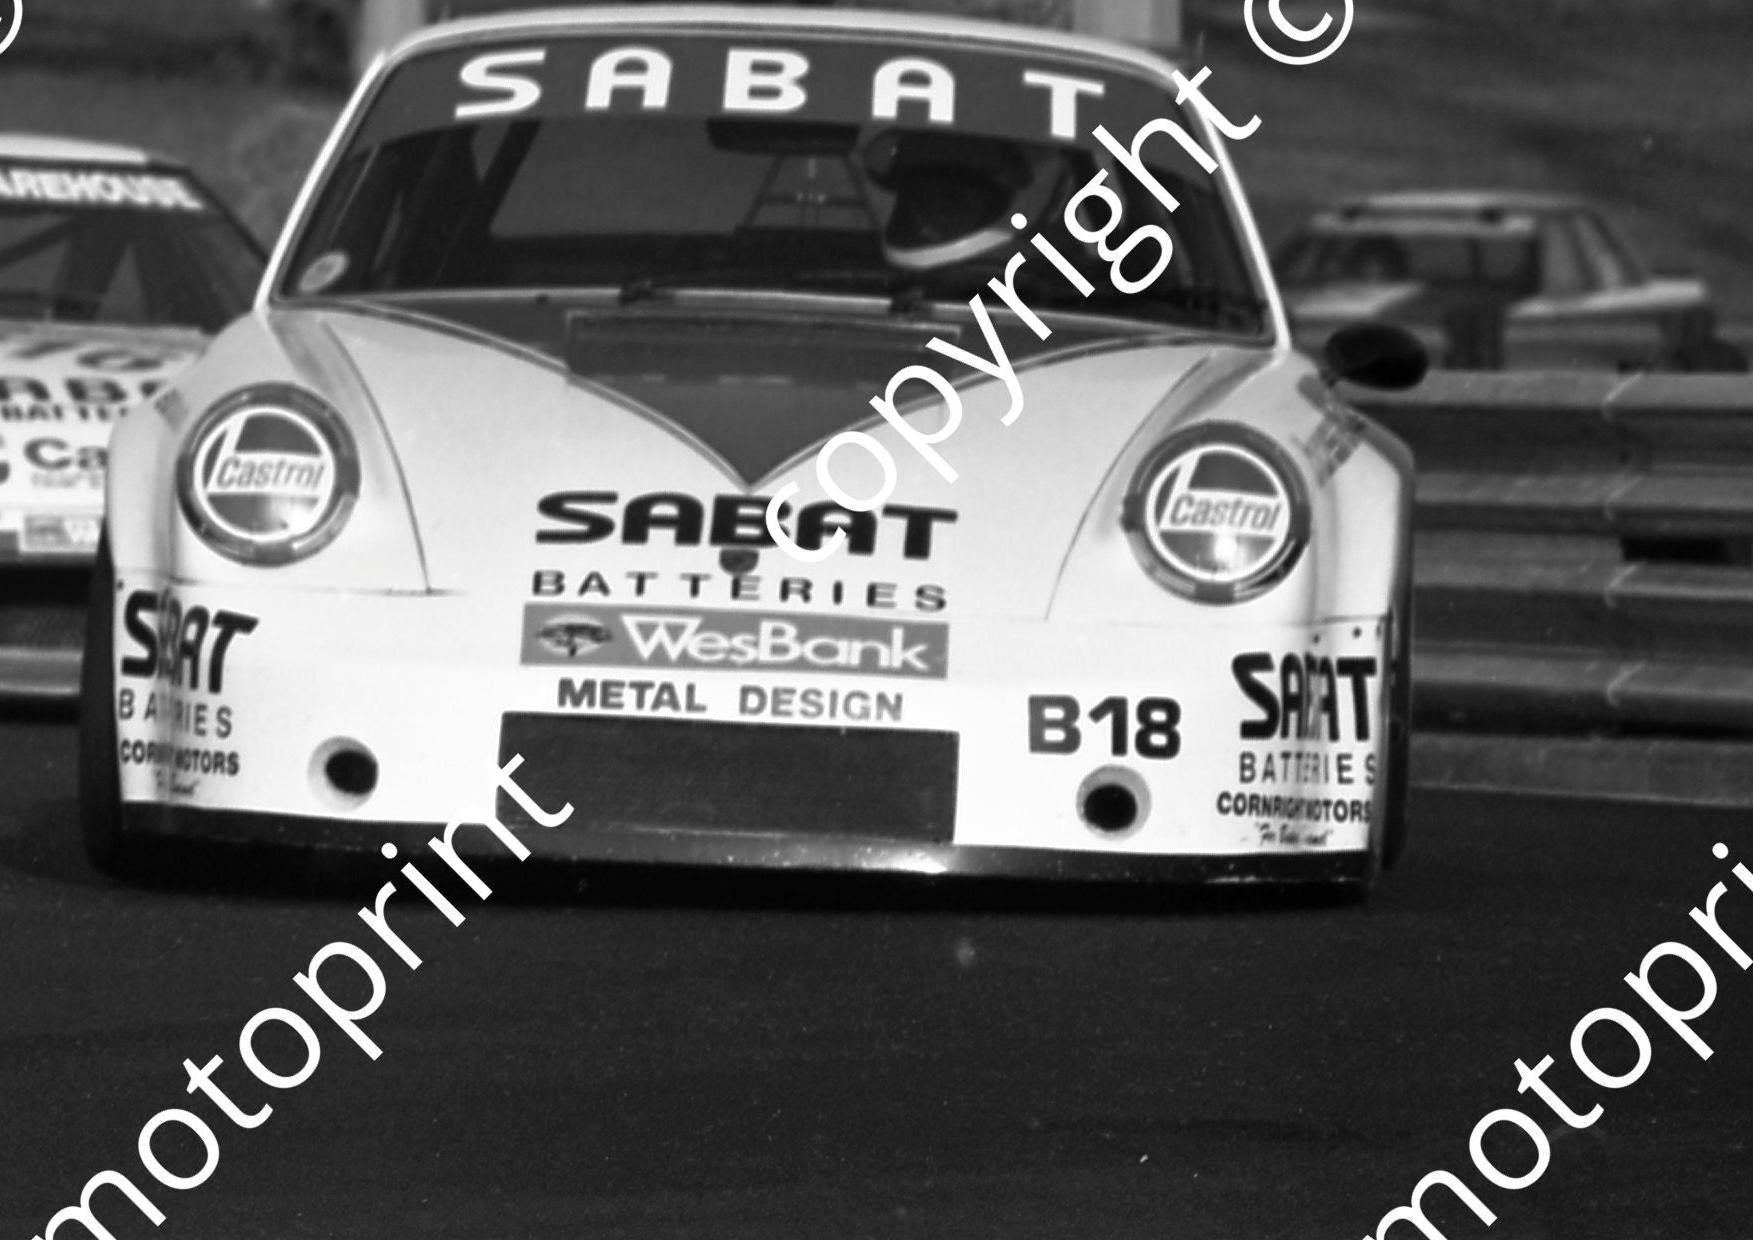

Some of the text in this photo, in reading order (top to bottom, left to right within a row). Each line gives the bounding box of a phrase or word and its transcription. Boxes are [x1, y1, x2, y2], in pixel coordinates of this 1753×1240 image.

[455, 46, 1105, 139] SABAT
[216, 458, 325, 491] Castrol
[535, 491, 958, 561] SABAT
[1169, 495, 1283, 531] Castrol
[532, 570, 948, 612] BATTERIES
[621, 613, 932, 673] WesBank
[557, 677, 904, 722] METAL DESIGN
[1028, 694, 1182, 760] B18
